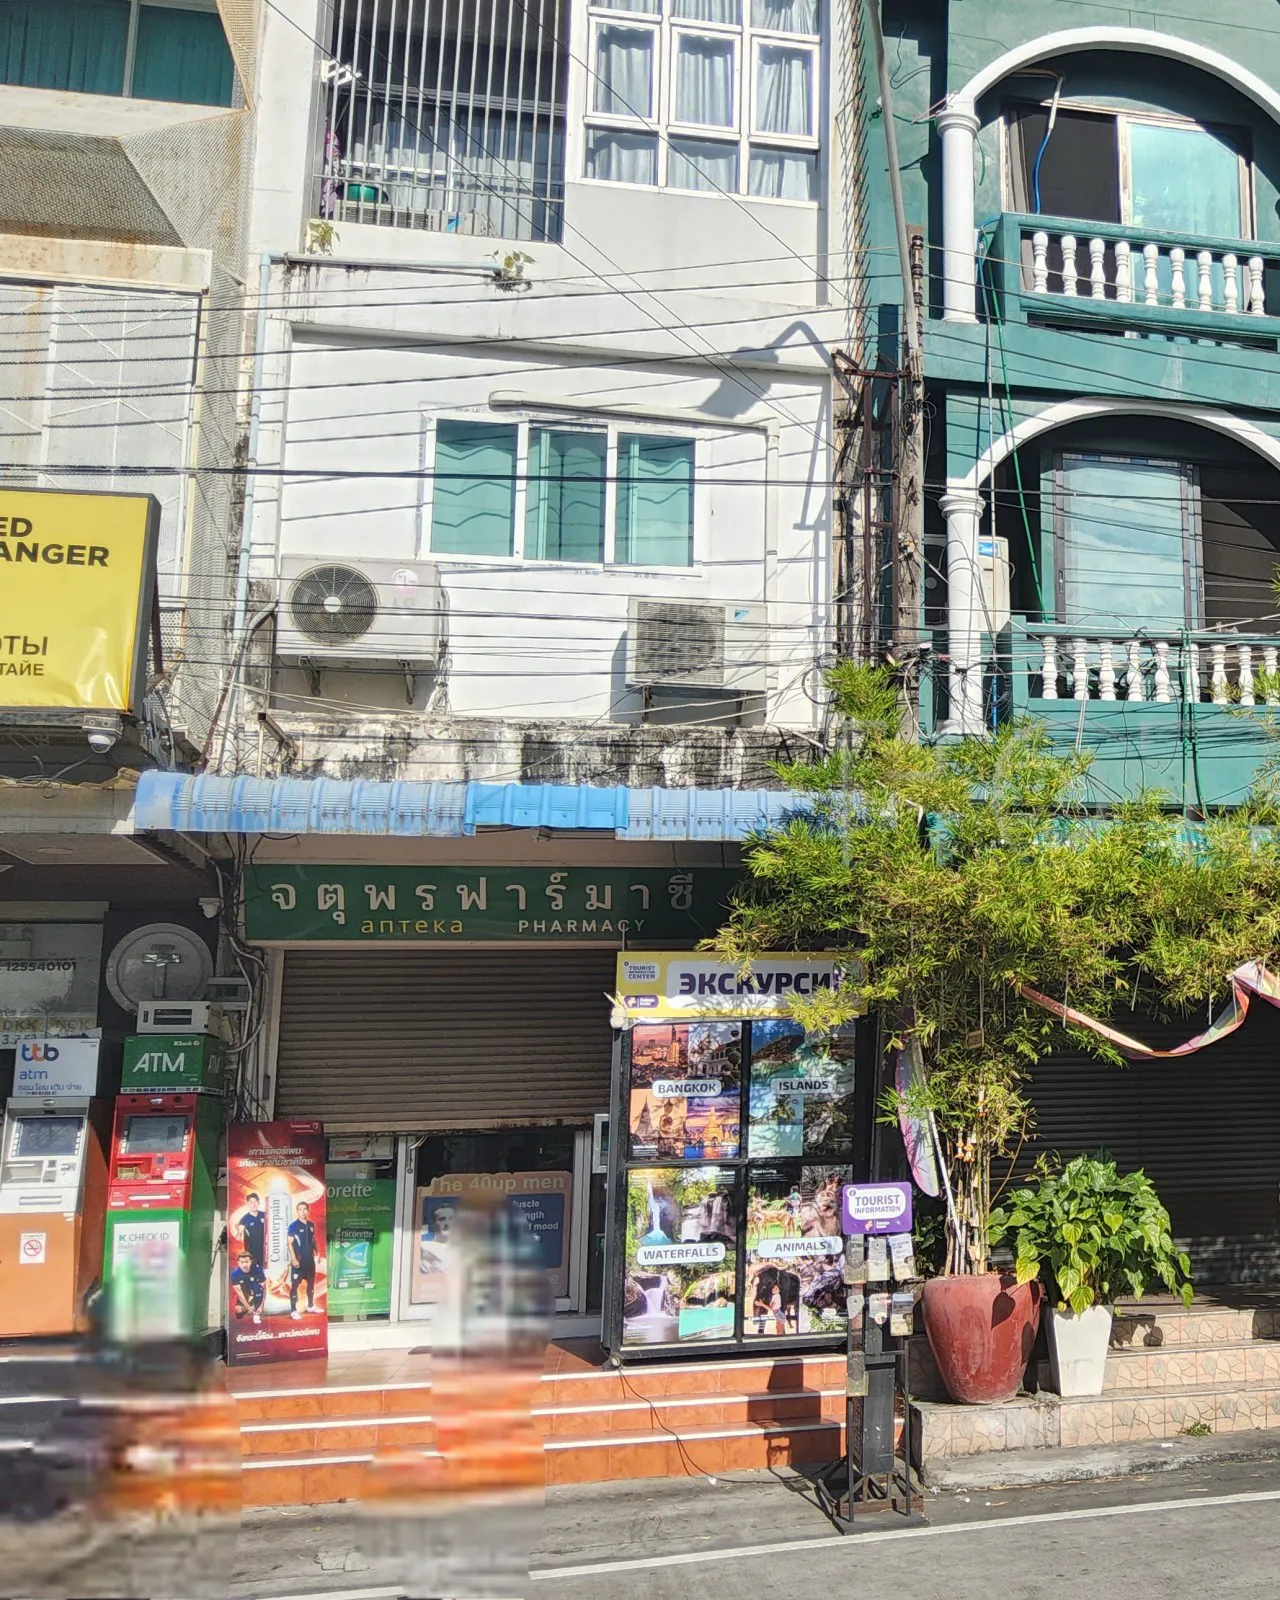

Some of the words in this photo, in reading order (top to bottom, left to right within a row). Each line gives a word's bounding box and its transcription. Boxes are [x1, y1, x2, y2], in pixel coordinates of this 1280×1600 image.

[0, 635, 48, 656] ТЫ
[361, 919, 464, 935] аптека
[518, 919, 646, 933] PHARMACY
[22, 1043, 59, 1061] ttb
[132, 1052, 185, 1072] ATM
[19, 1069, 48, 1080] atm
[657, 1081, 717, 1094] BANGKOK
[778, 1079, 829, 1091] ISLANDS
[468, 1176, 517, 1193] 40up
[522, 1176, 564, 1189] men
[855, 1194, 900, 1206] TOURIST
[854, 1205, 900, 1214] INFORMATION
[270, 1199, 283, 1263] Counterpain
[533, 1222, 559, 1230] mood
[128, 1233, 158, 1241] CHECK
[160, 1232, 170, 1241] ID
[341, 1230, 373, 1239] nicorette
[774, 1240, 827, 1252] ANIMALS
[643, 1247, 719, 1260] WATERFALLS
